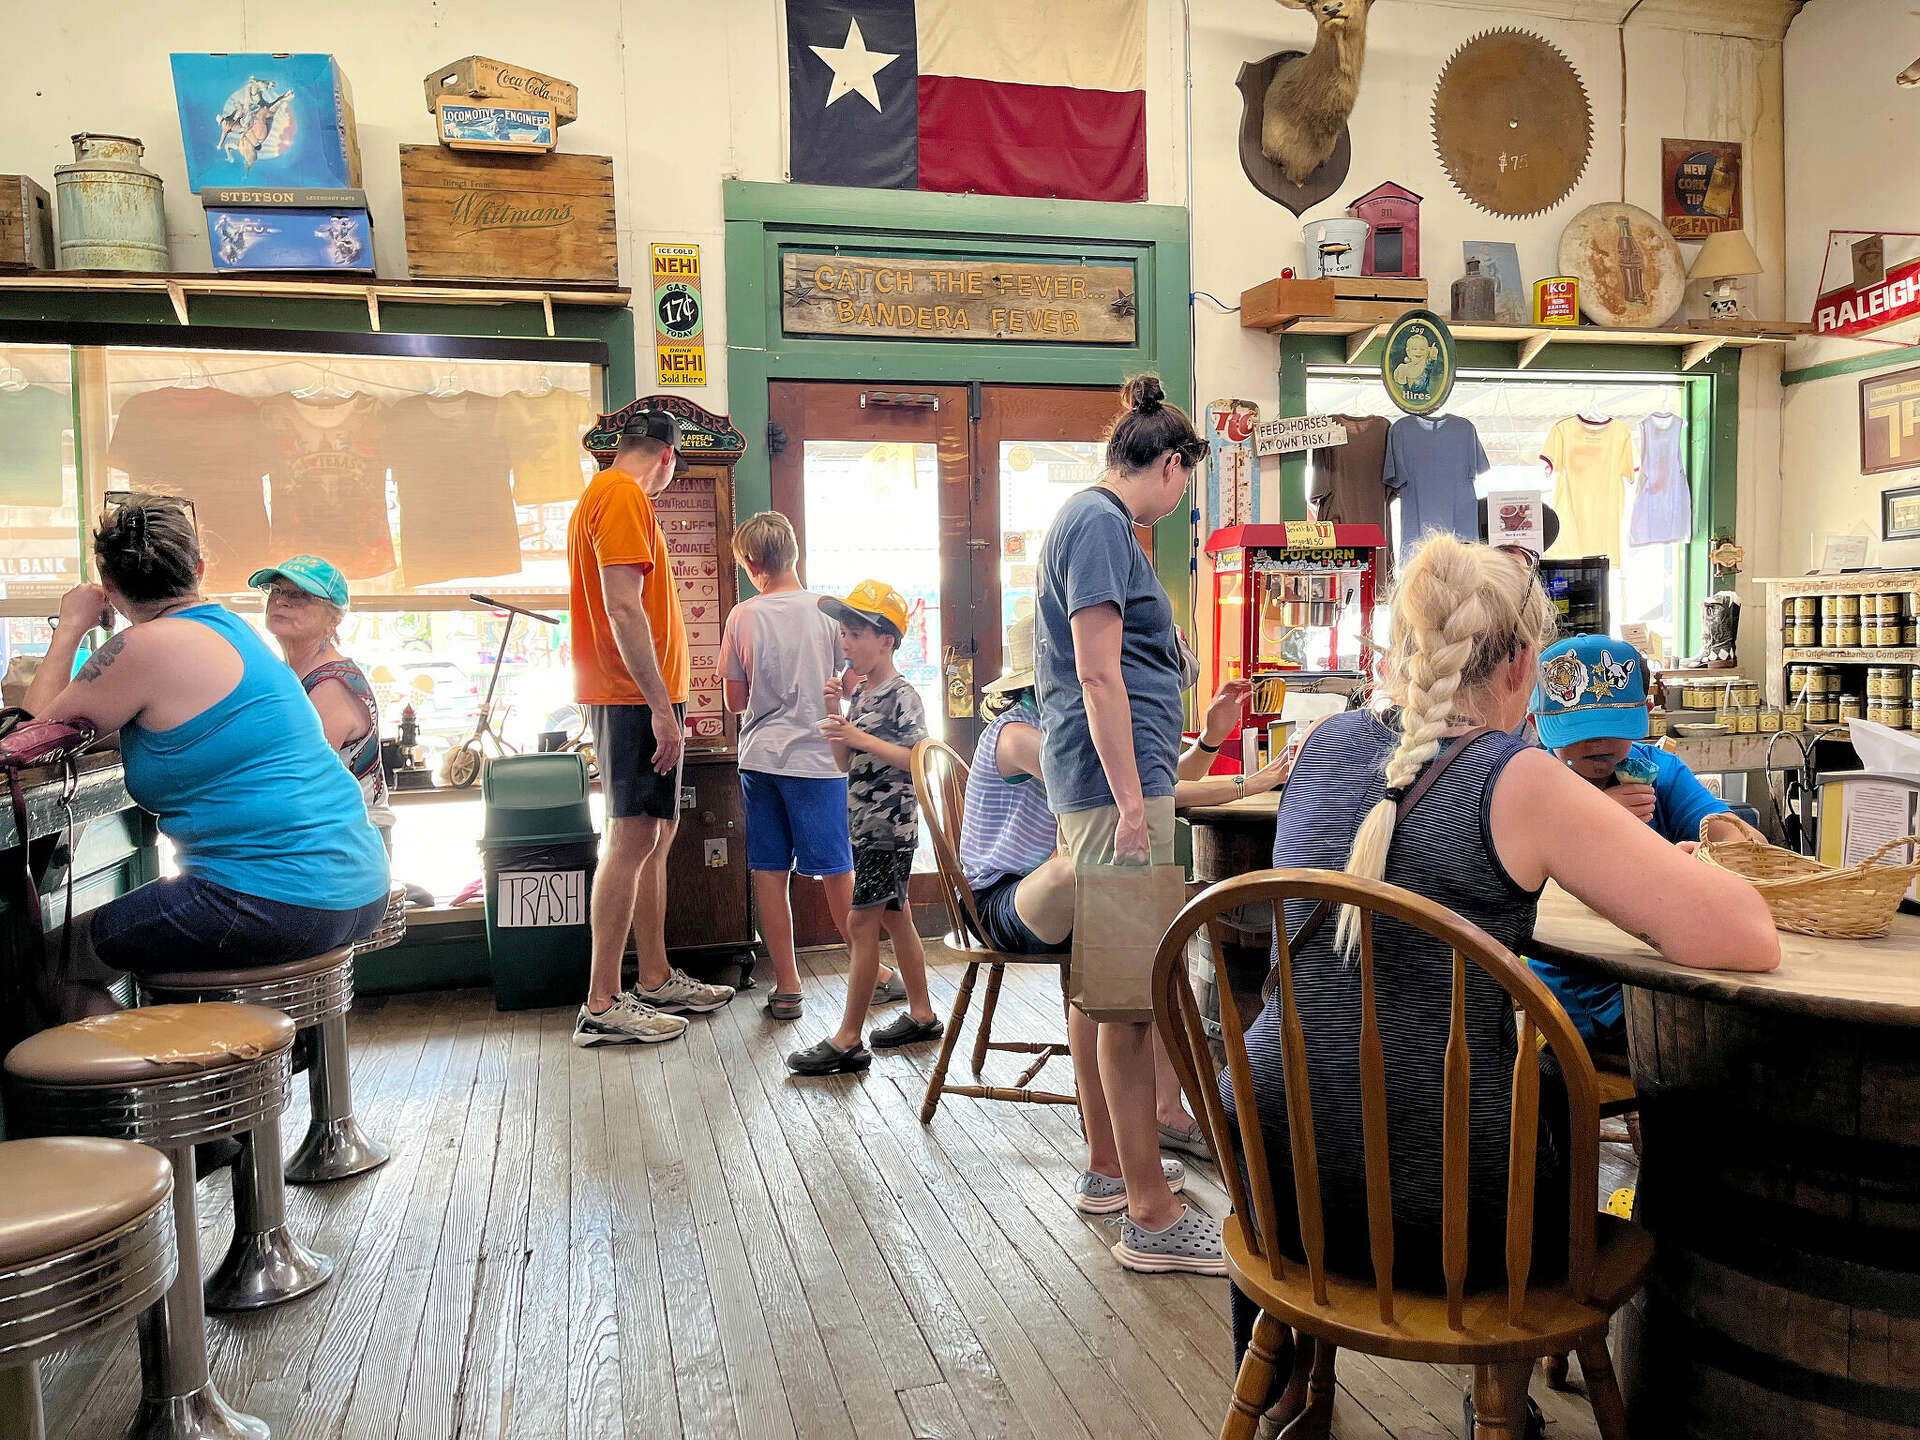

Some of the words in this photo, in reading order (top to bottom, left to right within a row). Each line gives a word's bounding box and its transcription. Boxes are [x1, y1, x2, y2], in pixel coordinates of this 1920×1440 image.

[443, 108, 495, 123] LOCOMOTIVE
[1683, 164, 1707, 176] NEW
[220, 191, 295, 203] STETSON
[1686, 193, 1703, 205] TIP
[446, 190, 574, 230] Whitman's
[1691, 217, 1740, 233] FATIMA
[655, 257, 698, 274] NEHI
[814, 264, 914, 294] CATCH
[930, 271, 983, 295] THE
[666, 284, 687, 292] GAS
[662, 293, 695, 325] 17¢
[837, 298, 970, 330] BANDERA
[992, 308, 1081, 333] FEVER
[666, 329, 693, 338] TODAY
[1410, 325, 1425, 335] Say
[660, 354, 703, 372] NEHI
[661, 374, 680, 383] Sold
[682, 374, 703, 384] Here
[1402, 390, 1431, 400] Hires
[605, 401, 649, 433] LOVE
[654, 399, 728, 434] TESTER
[1260, 423, 1285, 438] FEED
[1291, 416, 1328, 432] HORSES
[1260, 440, 1272, 452] AT
[1276, 438, 1298, 450] OWN
[671, 520, 705, 531] STUFF
[1279, 548, 1355, 561] POPCORN
[20, 557, 67, 574] BANK
[1787, 583, 1801, 592] The
[1804, 582, 1834, 592] Original
[1835, 580, 1874, 590] Habanero
[1876, 578, 1917, 590] Company
[1791, 649, 1805, 658] The
[1875, 650, 1916, 660] Company
[500, 873, 579, 926] TRASH
